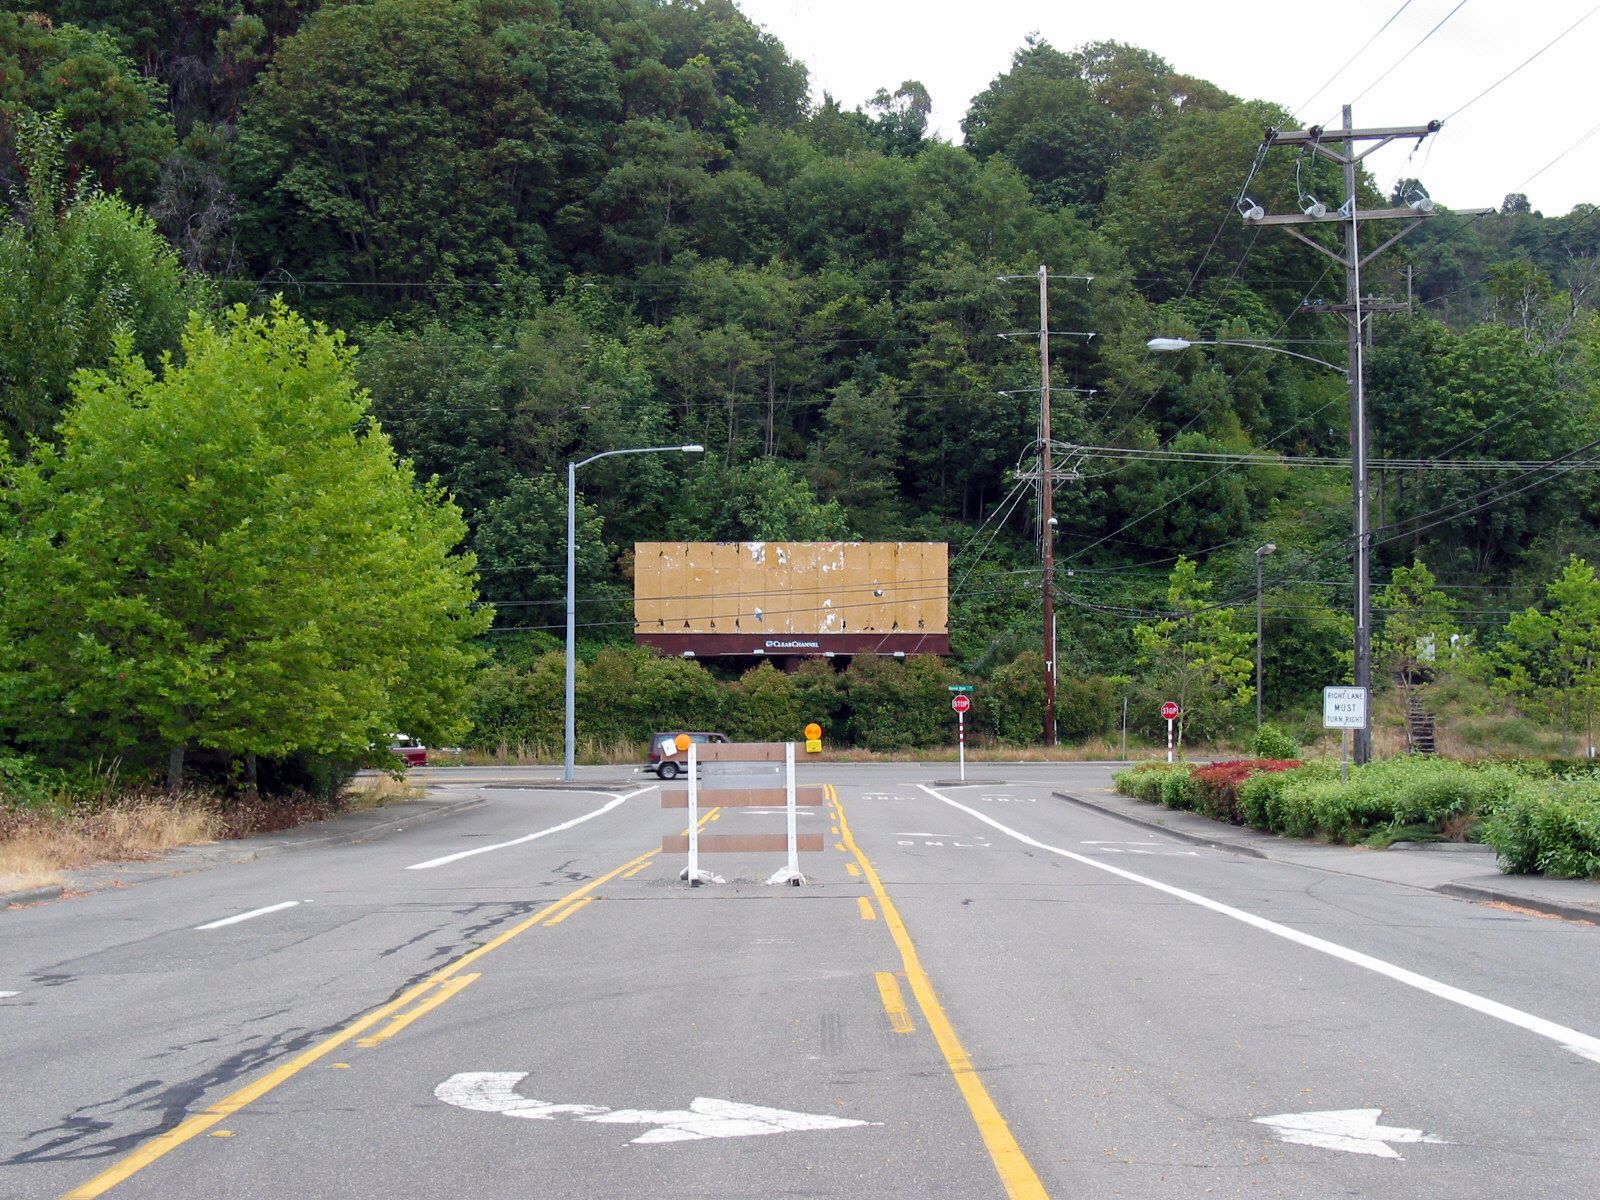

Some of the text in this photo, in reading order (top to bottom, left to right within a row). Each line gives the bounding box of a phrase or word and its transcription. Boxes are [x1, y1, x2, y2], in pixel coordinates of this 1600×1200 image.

[1327, 692, 1345, 700] RIGHT
[954, 700, 970, 708] STOP
[1334, 703, 1356, 712] MUST
[1162, 707, 1177, 715] STOP
[1327, 715, 1343, 723] TURN
